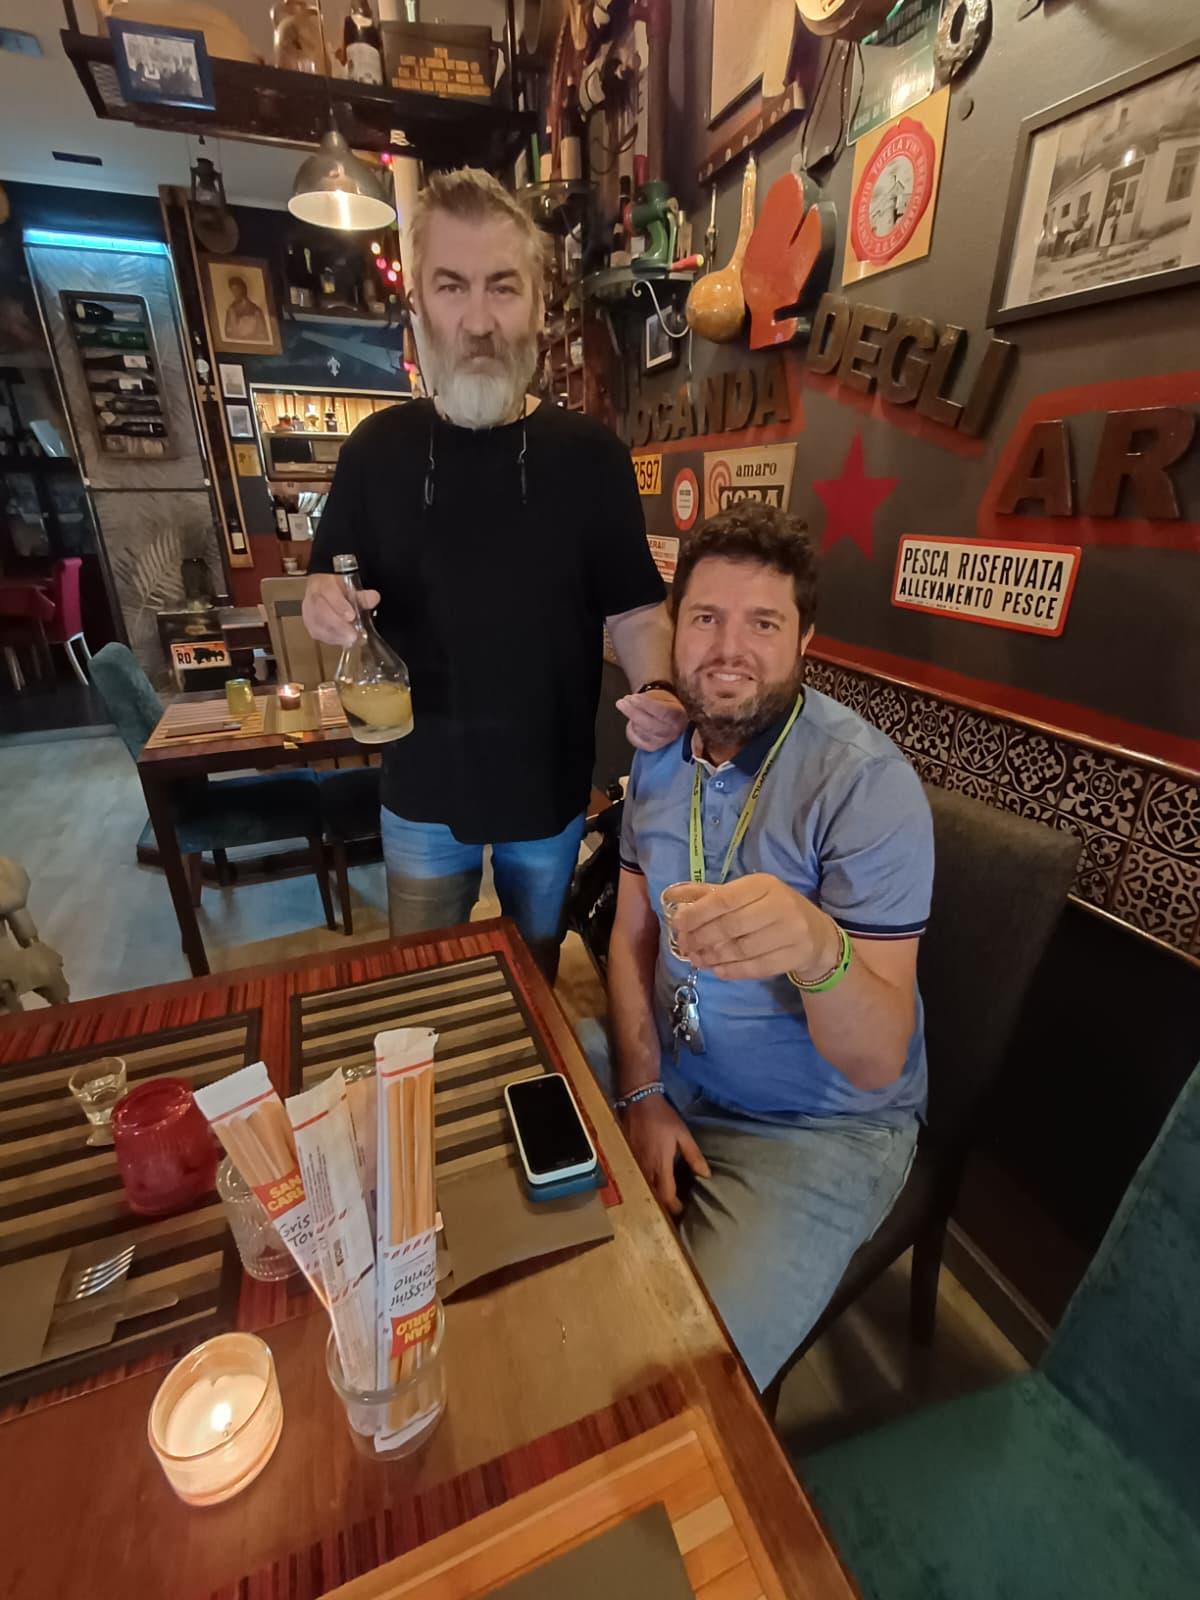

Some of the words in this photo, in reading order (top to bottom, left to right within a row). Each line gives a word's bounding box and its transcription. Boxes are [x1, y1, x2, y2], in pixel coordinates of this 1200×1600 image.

[806, 293, 1012, 438] DEGLI
[995, 406, 1196, 518] AR
[735, 462, 777, 478] amaro
[902, 547, 949, 578] PESCA
[956, 552, 1064, 593] RISERVATA
[899, 577, 994, 610] ALLEVAMENTO
[1001, 591, 1058, 620] PESCE
[268, 1174, 303, 1198] SAN
[404, 1320, 432, 1344] SAN
